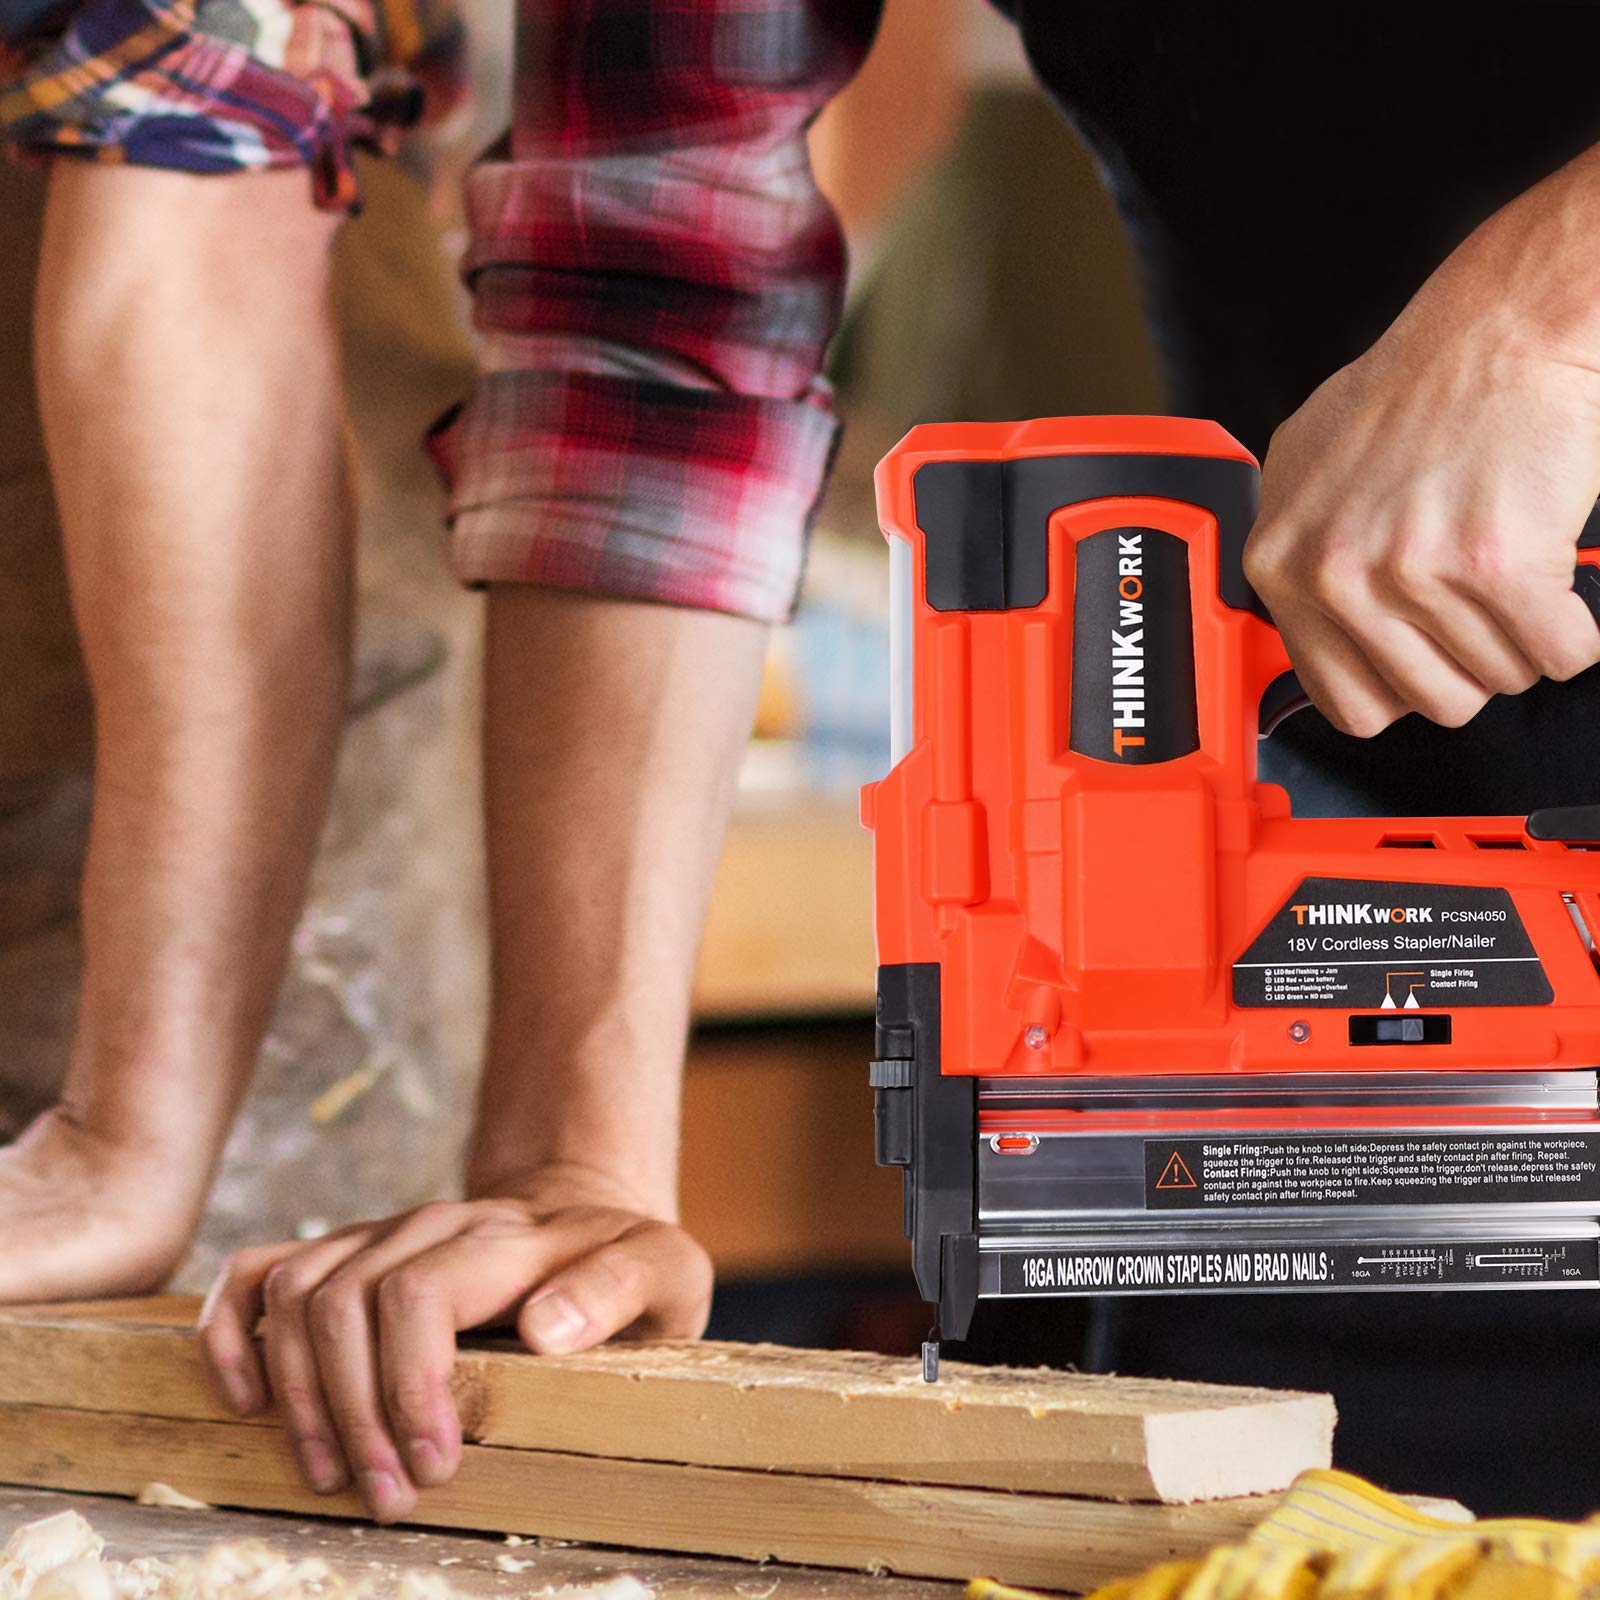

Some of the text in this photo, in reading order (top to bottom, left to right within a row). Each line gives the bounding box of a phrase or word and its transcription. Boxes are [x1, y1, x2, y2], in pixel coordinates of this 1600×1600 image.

[1442, 911, 1506, 921] PCSN4050
[1288, 935, 1496, 951] 18V Cordless Stapler/Nailer
[1430, 969, 1473, 978] Single Firing
[1459, 980, 1478, 988] Firing
[1203, 1146, 1231, 1157] Single
[1286, 1146, 1299, 1154] the
[1302, 1145, 1322, 1153] knob
[1325, 1145, 1332, 1153] to
[1335, 1144, 1348, 1153] left
[1407, 1143, 1420, 1151] the
[1422, 1142, 1447, 1152] safety
[1482, 1142, 1494, 1151] pin
[1497, 1142, 1527, 1151] against
[1543, 1140, 1588, 1149] workpiece,
[1203, 1160, 1239, 1169] squeeze
[1241, 1159, 1254, 1167] the
[1256, 1158, 1284, 1167] trigger
[1286, 1158, 1294, 1166] to
[1369, 1155, 1396, 1164] trigger
[1399, 1154, 1414, 1163] and
[1417, 1153, 1441, 1163] safety
[1444, 1153, 1474, 1162] contact
[1476, 1153, 1488, 1162] pin
[1491, 1152, 1510, 1161] after
[1512, 1151, 1535, 1162] firing.
[1538, 1151, 1570, 1161] Repeat.
[1203, 1169, 1239, 1178] Contact
[1294, 1168, 1307, 1176] the
[1309, 1167, 1329, 1176] knob
[1331, 1167, 1339, 1175] to
[1341, 1166, 1360, 1177] right
[1421, 1165, 1434, 1173] the
[1556, 1163, 1569, 1171] the
[1571, 1162, 1596, 1172] safety
[1204, 1182, 1235, 1190] contact
[1237, 1181, 1249, 1191] pin
[1252, 1180, 1282, 1190] against
[1285, 1180, 1298, 1188] the
[1300, 1178, 1342, 1188] workpiece
[1344, 1178, 1352, 1186] to
[1395, 1176, 1437, 1186] squeezing
[1439, 1176, 1452, 1184] the
[1454, 1175, 1481, 1185] trigger
[1484, 1175, 1493, 1183] all
[1495, 1175, 1508, 1183] the
[1510, 1174, 1528, 1182] time
[1530, 1174, 1543, 1182] but
[1546, 1173, 1581, 1182] released
[1204, 1193, 1229, 1202] safety
[1232, 1192, 1262, 1200] contact
[1265, 1191, 1277, 1201] pin
[1279, 1190, 1299, 1199] after
[1023, 1259, 1054, 1286] 18GA
[1057, 1257, 1114, 1285] NARROW
[1117, 1256, 1164, 1284] CROWN
[1167, 1255, 1222, 1283] STAPLES
[1225, 1254, 1251, 1281] AND
[1254, 1253, 1288, 1281] BRAD
[1292, 1252, 1327, 1280] NAILS
